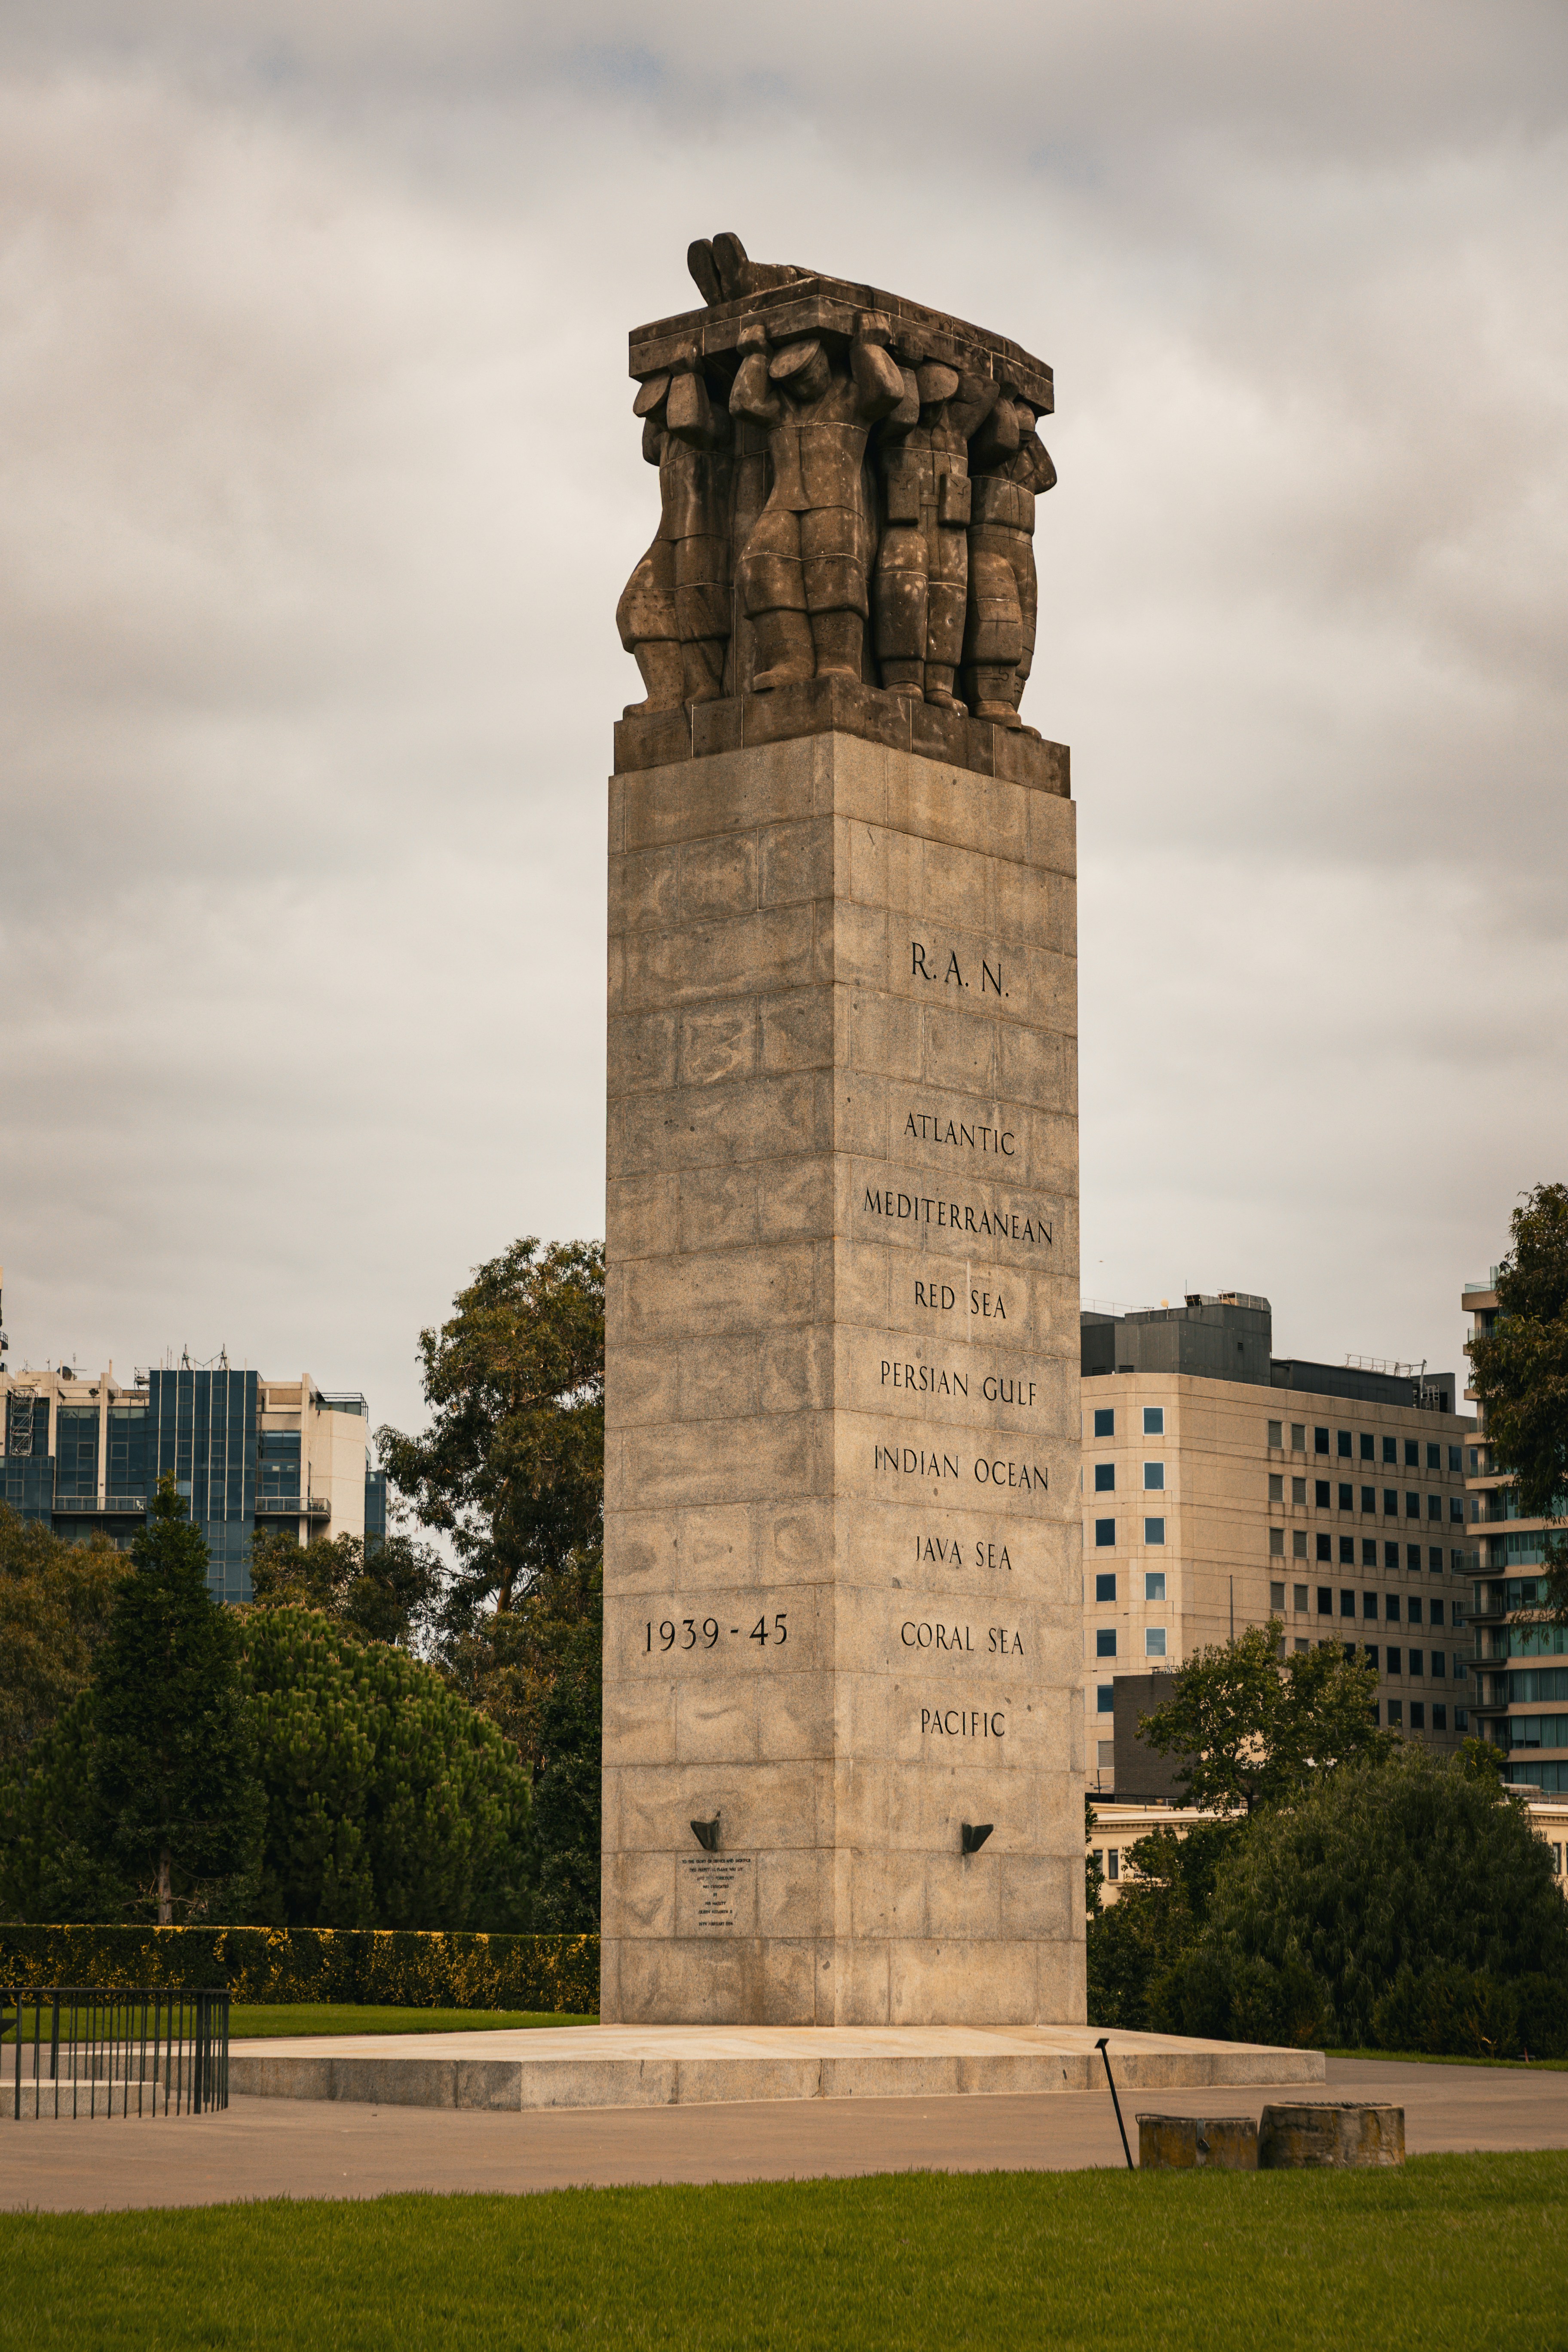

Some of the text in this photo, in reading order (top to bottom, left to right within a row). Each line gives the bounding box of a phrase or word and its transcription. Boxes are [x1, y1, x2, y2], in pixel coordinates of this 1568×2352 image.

[903, 1112, 1015, 1156] ATLANTIC
[863, 1187, 1053, 1246] MEDITERRANEAN
[915, 1281, 1007, 1319] RED SEA
[881, 1360, 1037, 1406] PERSIAN GULF
[874, 1445, 1048, 1491] INDIAN OCEAN
[916, 1536, 1012, 1570] JAVA SEA
[900, 1621, 1024, 1655] CORAL SEA
[921, 1709, 1005, 1737] PACIFIC
